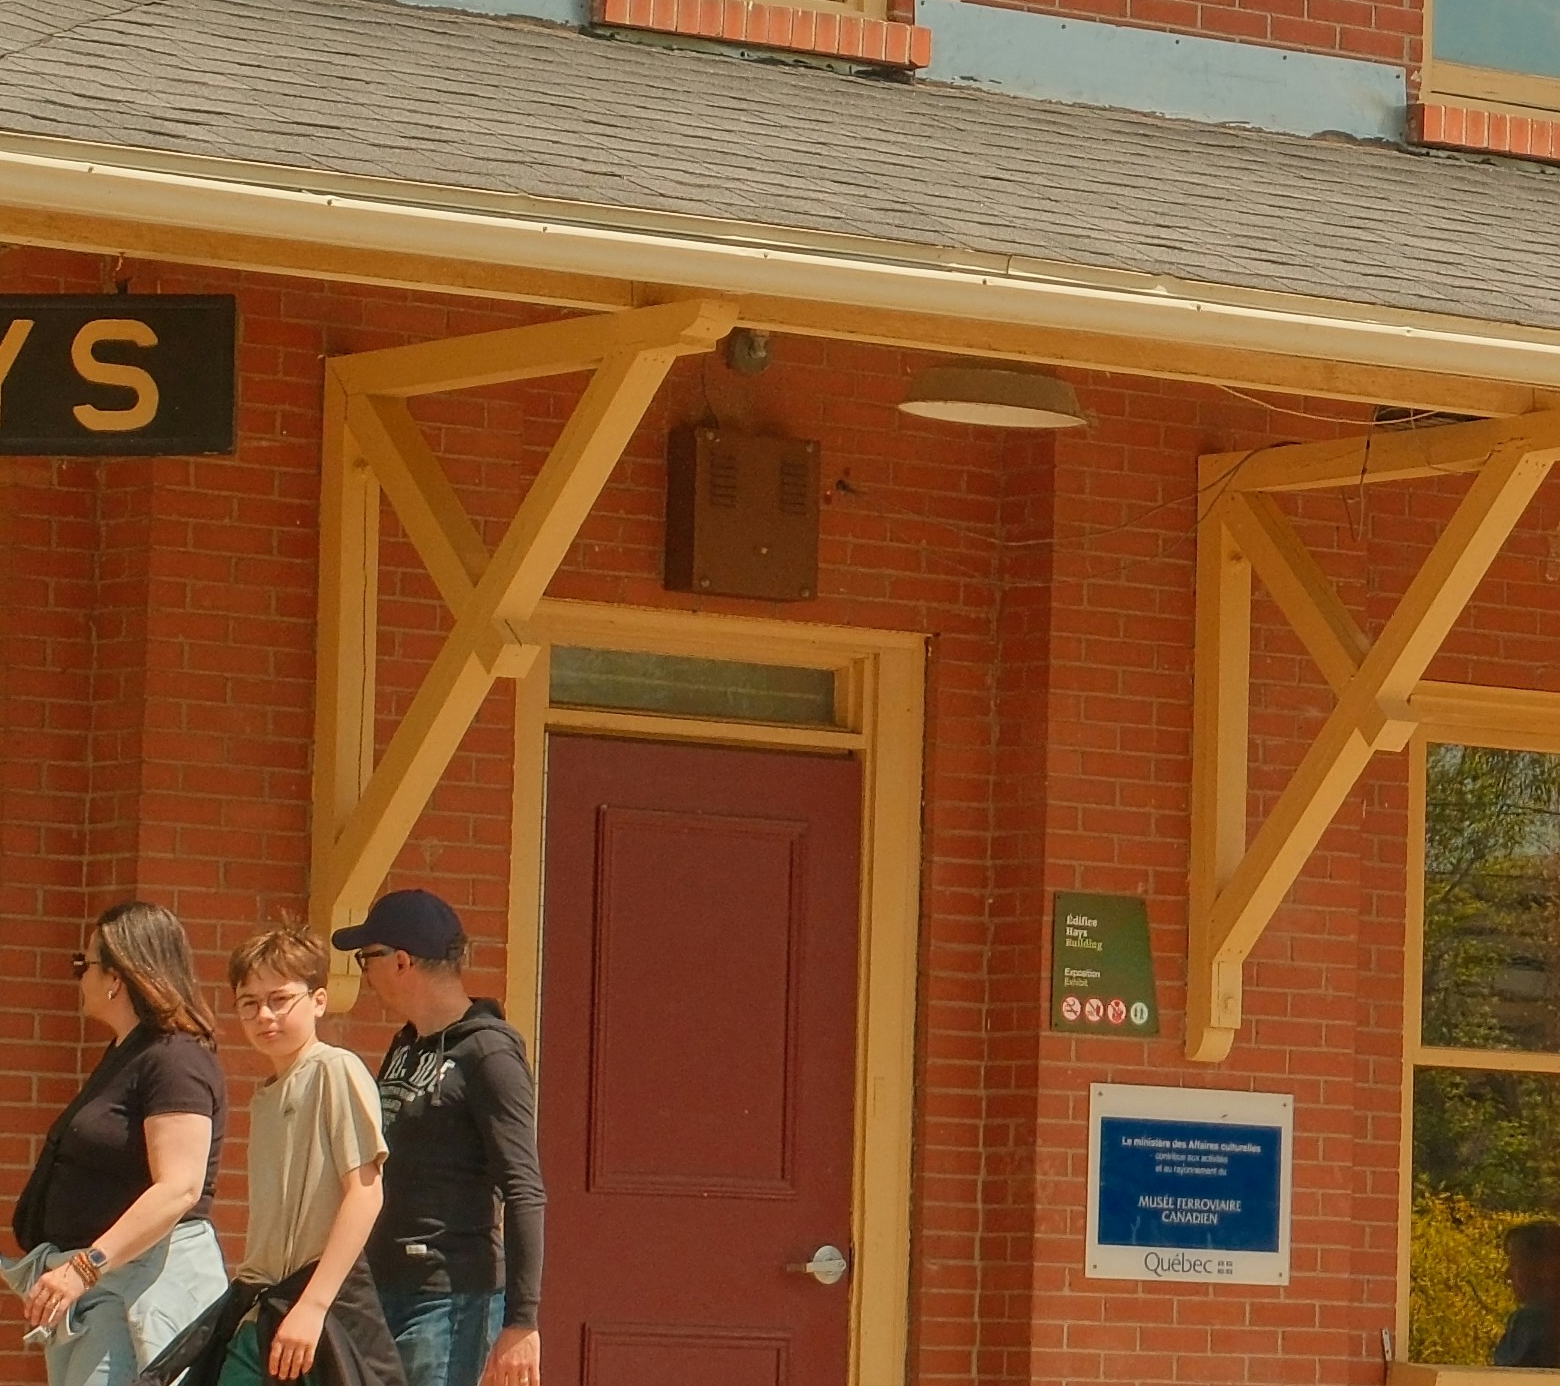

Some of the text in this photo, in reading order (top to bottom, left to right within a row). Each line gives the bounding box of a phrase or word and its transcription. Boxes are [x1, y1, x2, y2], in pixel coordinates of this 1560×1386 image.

[1065, 926, 1088, 939] Hays
[1065, 938, 1103, 951] Building
[1121, 1135, 1262, 1154] Le ministère des Affaires culturelles
[1138, 1194, 1242, 1212] MUSÉE FERROVIAIRE
[1161, 1211, 1218, 1225] CANADIEN
[1144, 1251, 1214, 1277] Québec
